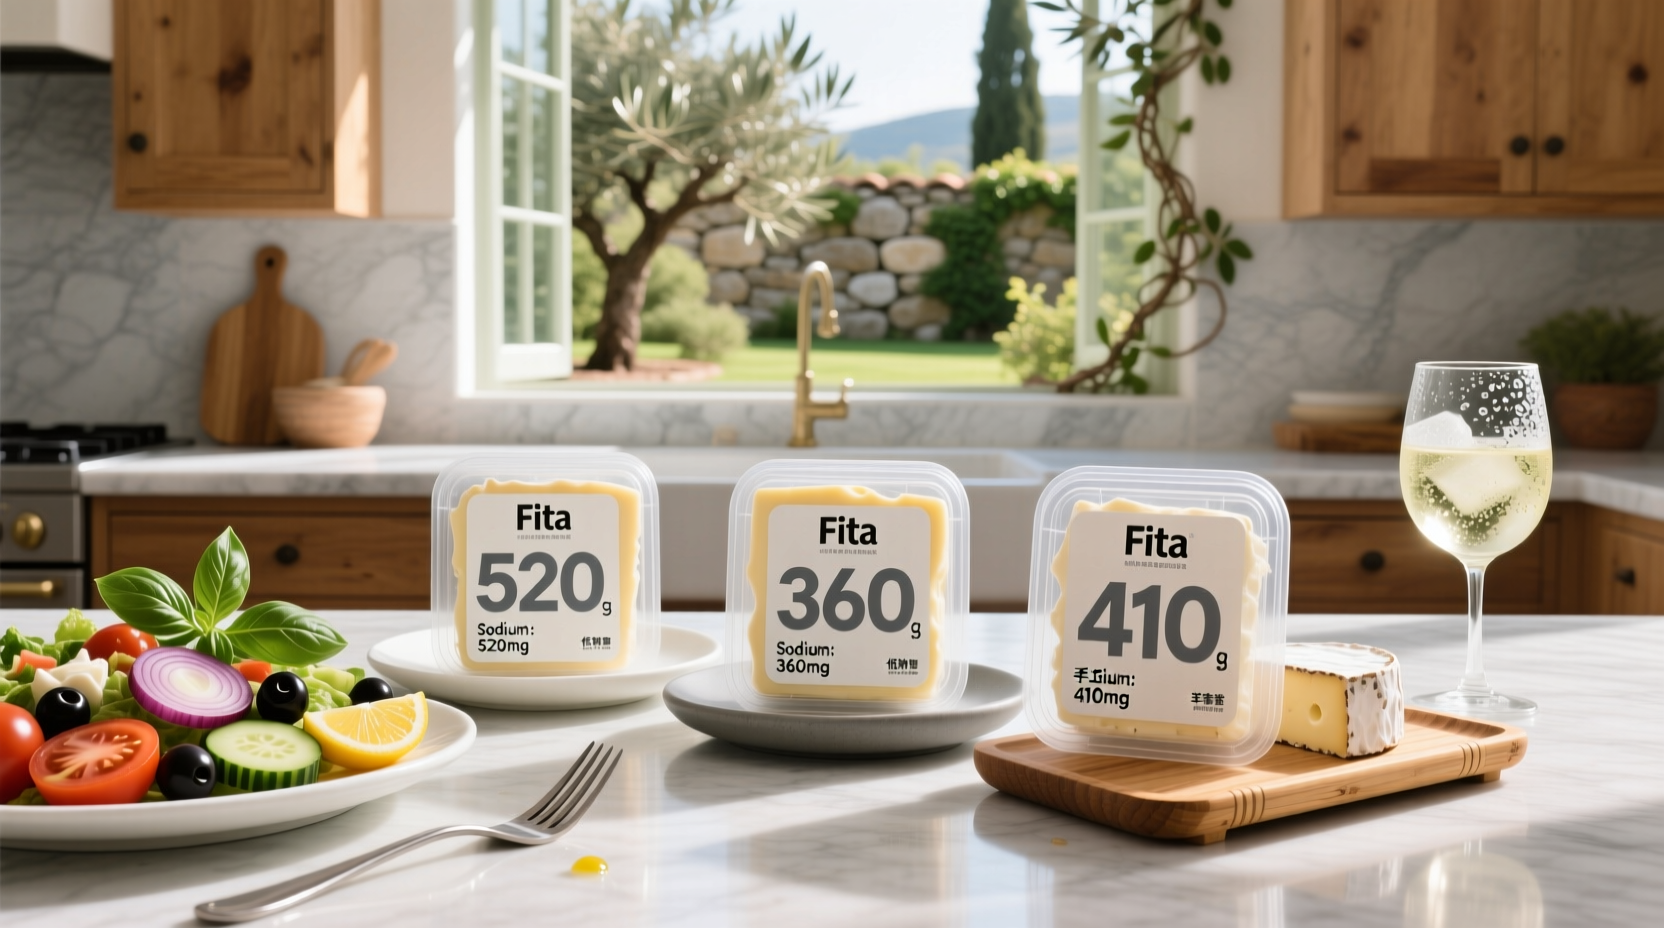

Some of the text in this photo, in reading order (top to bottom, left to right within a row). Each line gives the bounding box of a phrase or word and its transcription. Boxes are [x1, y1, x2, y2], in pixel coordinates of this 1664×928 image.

[516, 503, 572, 531] Fita
[819, 515, 878, 546] Fita
[1124, 524, 1189, 559] Fita
[477, 621, 535, 636] Sodium:
[477, 638, 529, 656] 520mg
[776, 640, 835, 657] Sodium:
[776, 658, 830, 678] 360mg
[1073, 686, 1130, 710] 410mg
